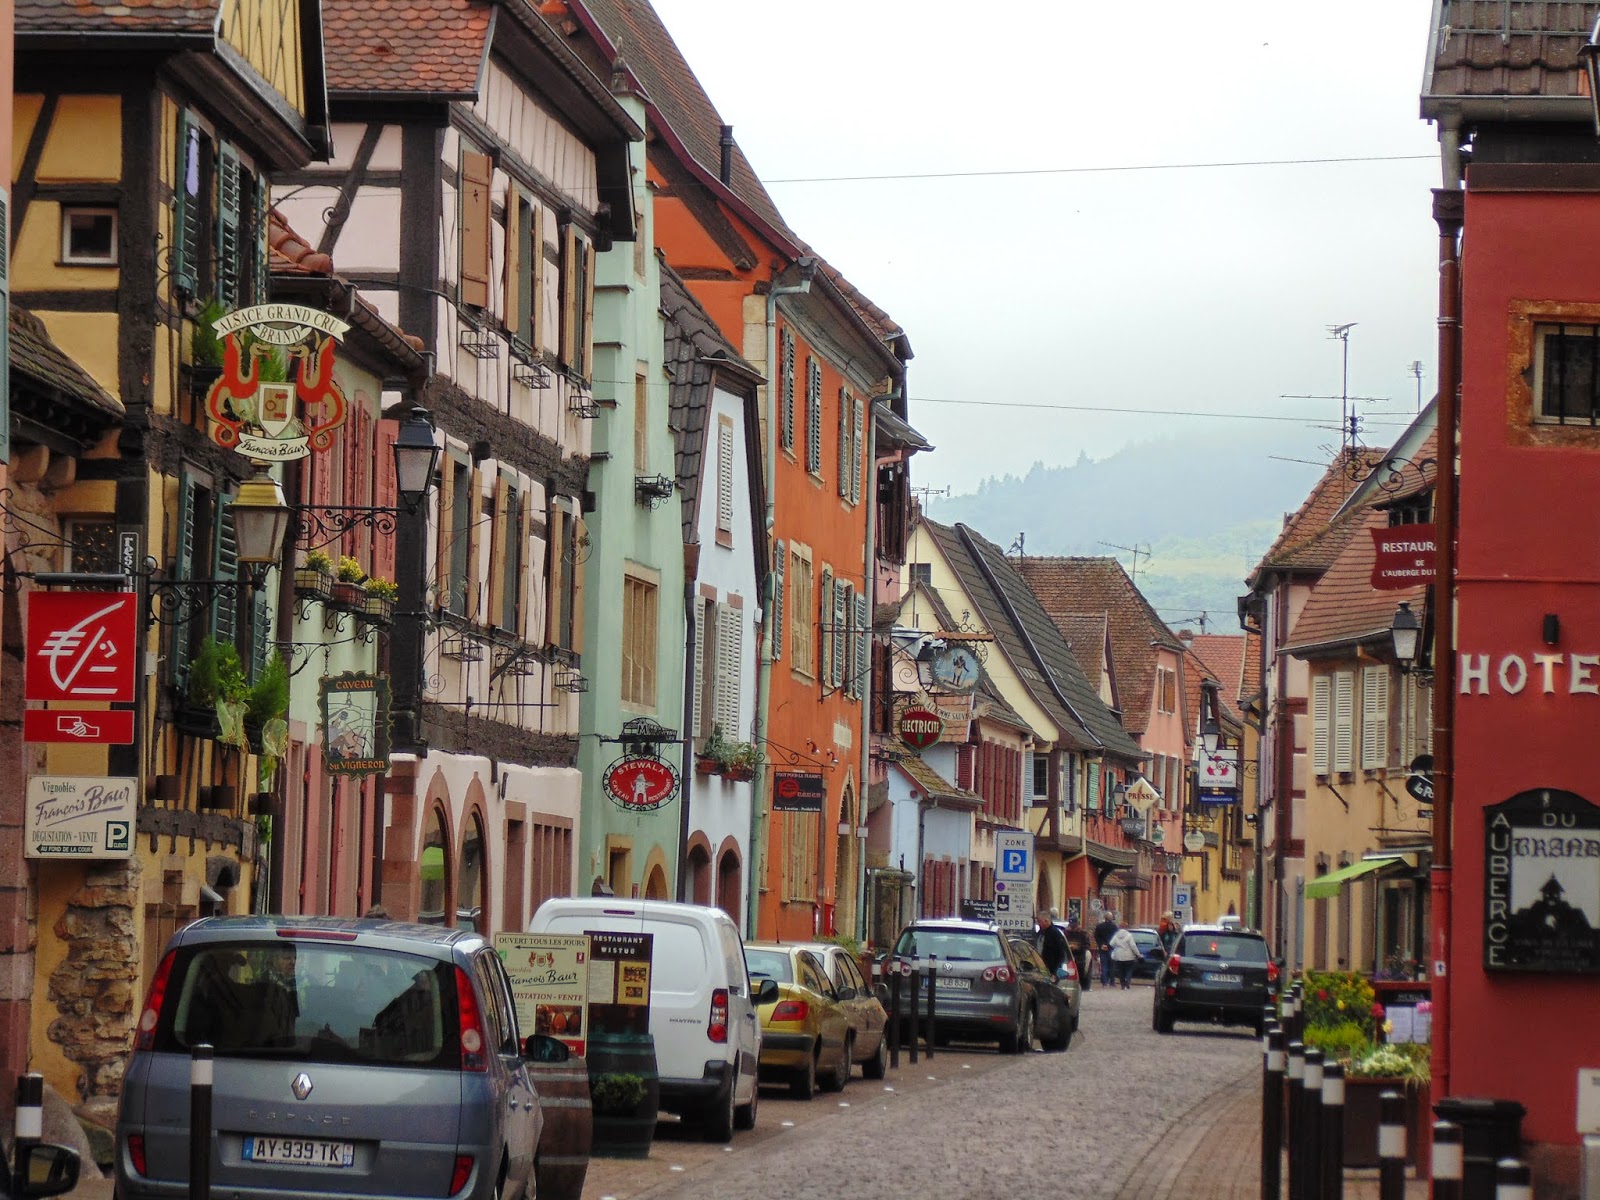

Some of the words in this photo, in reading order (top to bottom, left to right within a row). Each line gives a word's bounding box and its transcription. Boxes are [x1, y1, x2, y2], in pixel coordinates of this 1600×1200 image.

[219, 307, 264, 334] ALSACE
[267, 306, 311, 323] GRAND
[313, 313, 340, 334] CRU
[259, 326, 301, 343] BRAND
[278, 443, 306, 456] Baur
[1382, 541, 1458, 553] RESTAURT
[1415, 559, 1425, 567] DE
[1382, 569, 1420, 577] L'AUBERGE
[1421, 568, 1433, 576] DU
[341, 759, 385, 771] VIGNERON
[617, 761, 665, 775] STEWALA
[42, 781, 76, 794] Vignobles
[611, 779, 630, 801] CAVEAU
[647, 777, 672, 802] RESTAURANT
[84, 785, 130, 812] Baur
[1128, 792, 1155, 800] PRESSE
[1542, 812, 1576, 827] DU
[78, 831, 98, 843] VENTE
[1005, 839, 1027, 847] ZONE
[1512, 836, 1600, 858] BRAND
[1009, 852, 1022, 871] P
[997, 919, 1031, 928] RAPPEL
[499, 937, 528, 945] OUVERT
[593, 935, 644, 944] RESTAURANT
[546, 969, 578, 983] Baur
[514, 992, 553, 1000] USTATION
